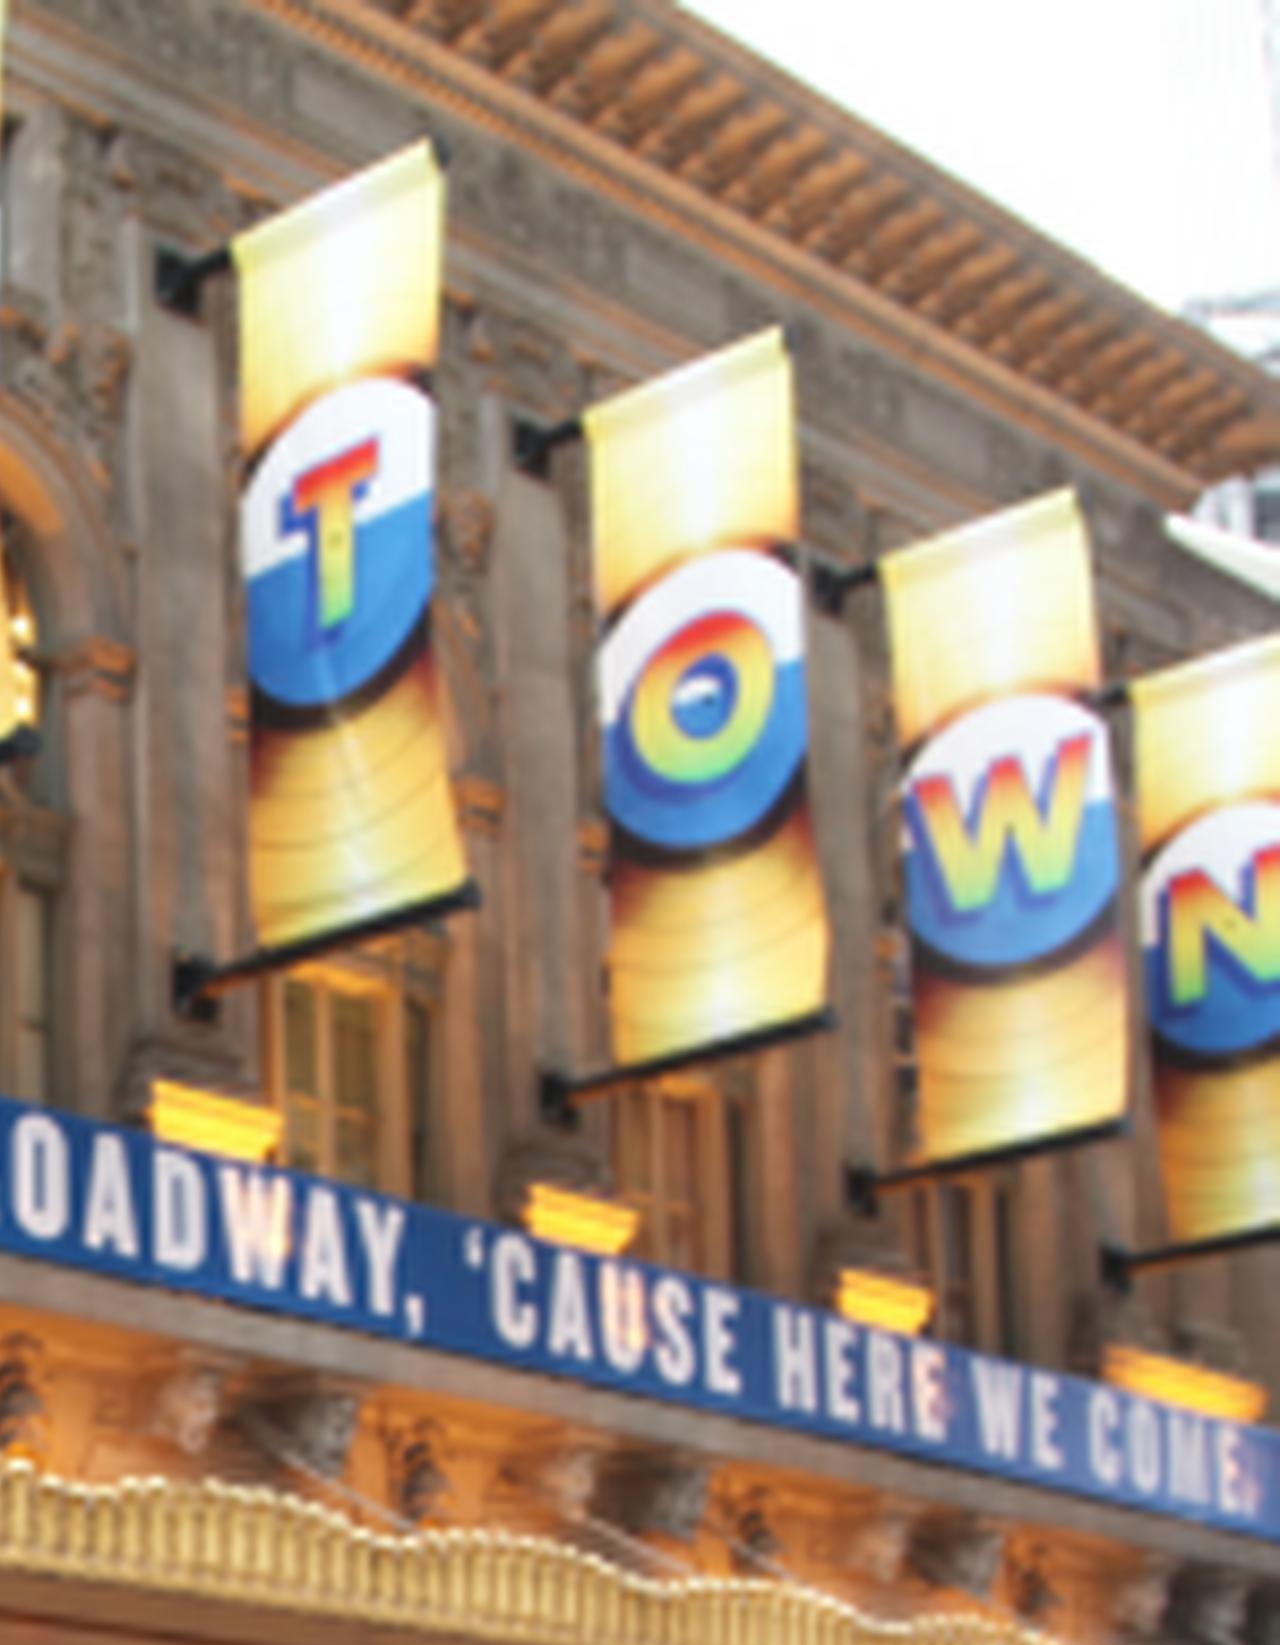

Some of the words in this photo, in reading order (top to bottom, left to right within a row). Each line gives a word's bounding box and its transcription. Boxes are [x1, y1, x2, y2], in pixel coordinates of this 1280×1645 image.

[292, 438, 380, 630] T
[629, 608, 776, 786] O
[911, 735, 1094, 914] W
[1166, 840, 1280, 1008] N
[772, 1306, 946, 1444] HERE
[971, 1355, 1064, 1471] WE
